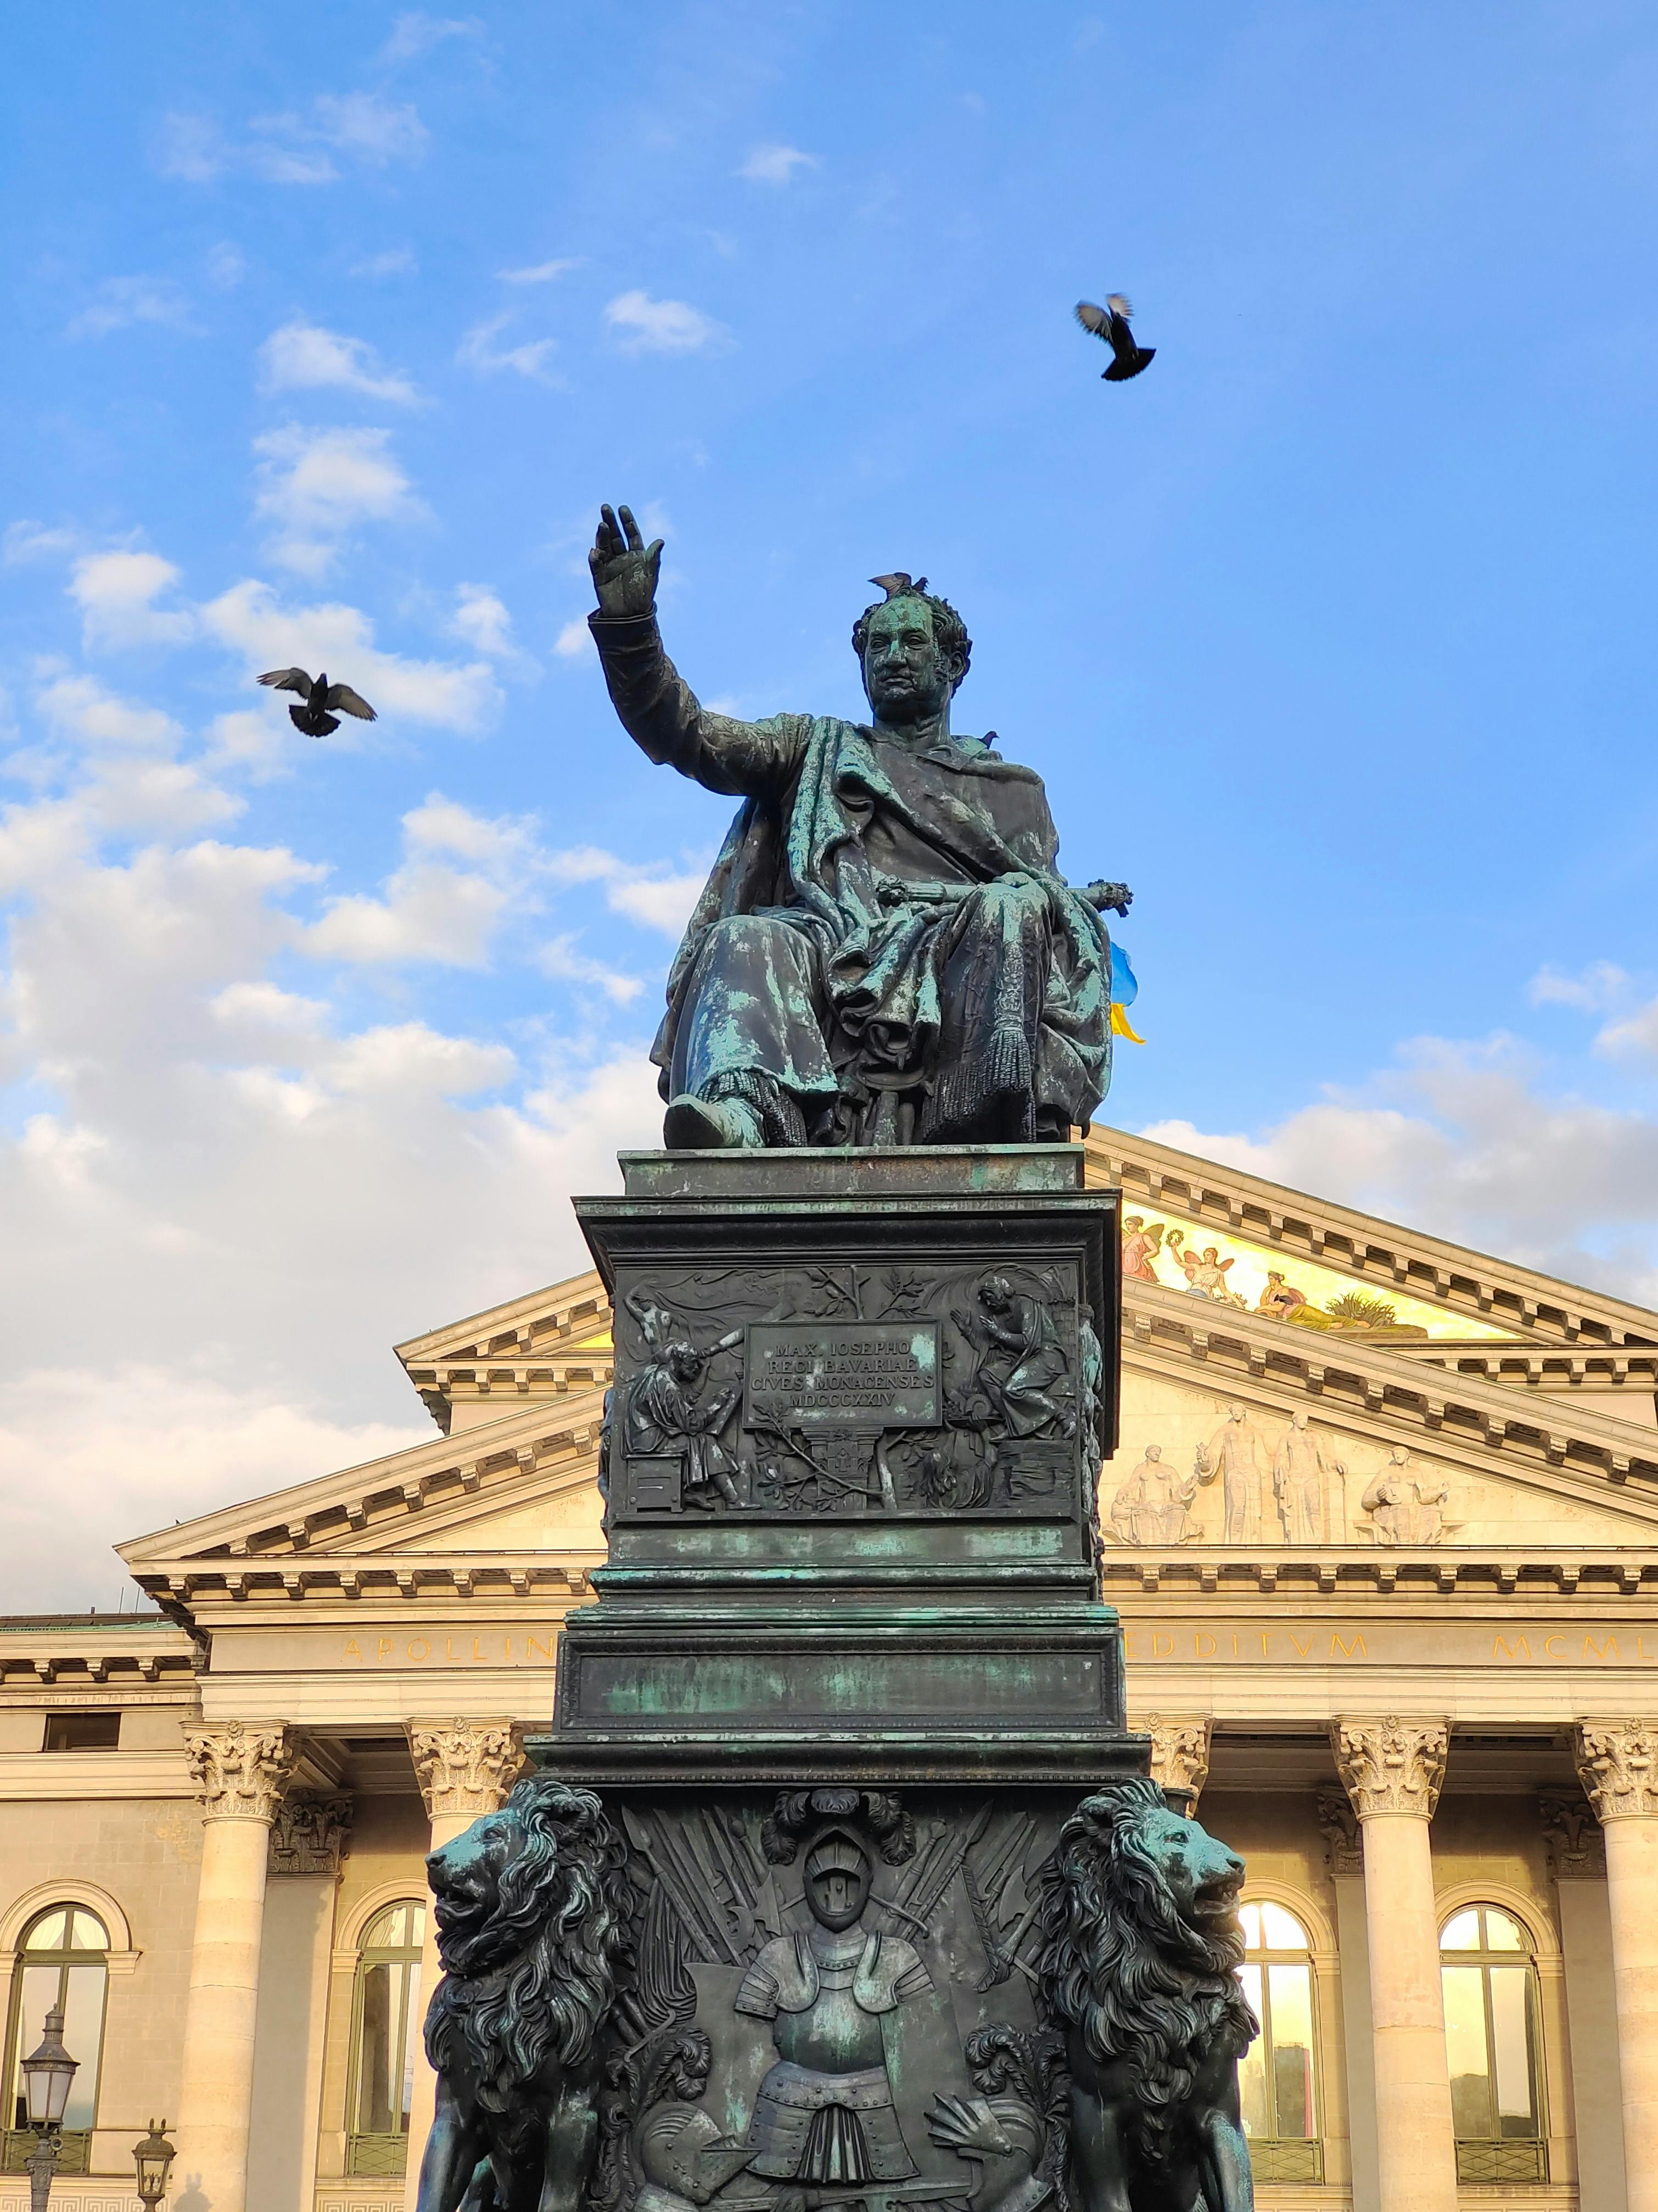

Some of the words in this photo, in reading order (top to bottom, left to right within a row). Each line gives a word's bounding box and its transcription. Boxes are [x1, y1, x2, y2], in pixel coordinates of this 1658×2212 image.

[776, 1344, 823, 1357] MAX.
[831, 1342, 910, 1356] IOSEPHO
[768, 1360, 813, 1374] REGI
[824, 1359, 918, 1373] BAVARIAE
[751, 1377, 804, 1391] CIVES
[815, 1376, 934, 1390] MONACENSES
[789, 1393, 895, 1407] MDCCCXXIV
